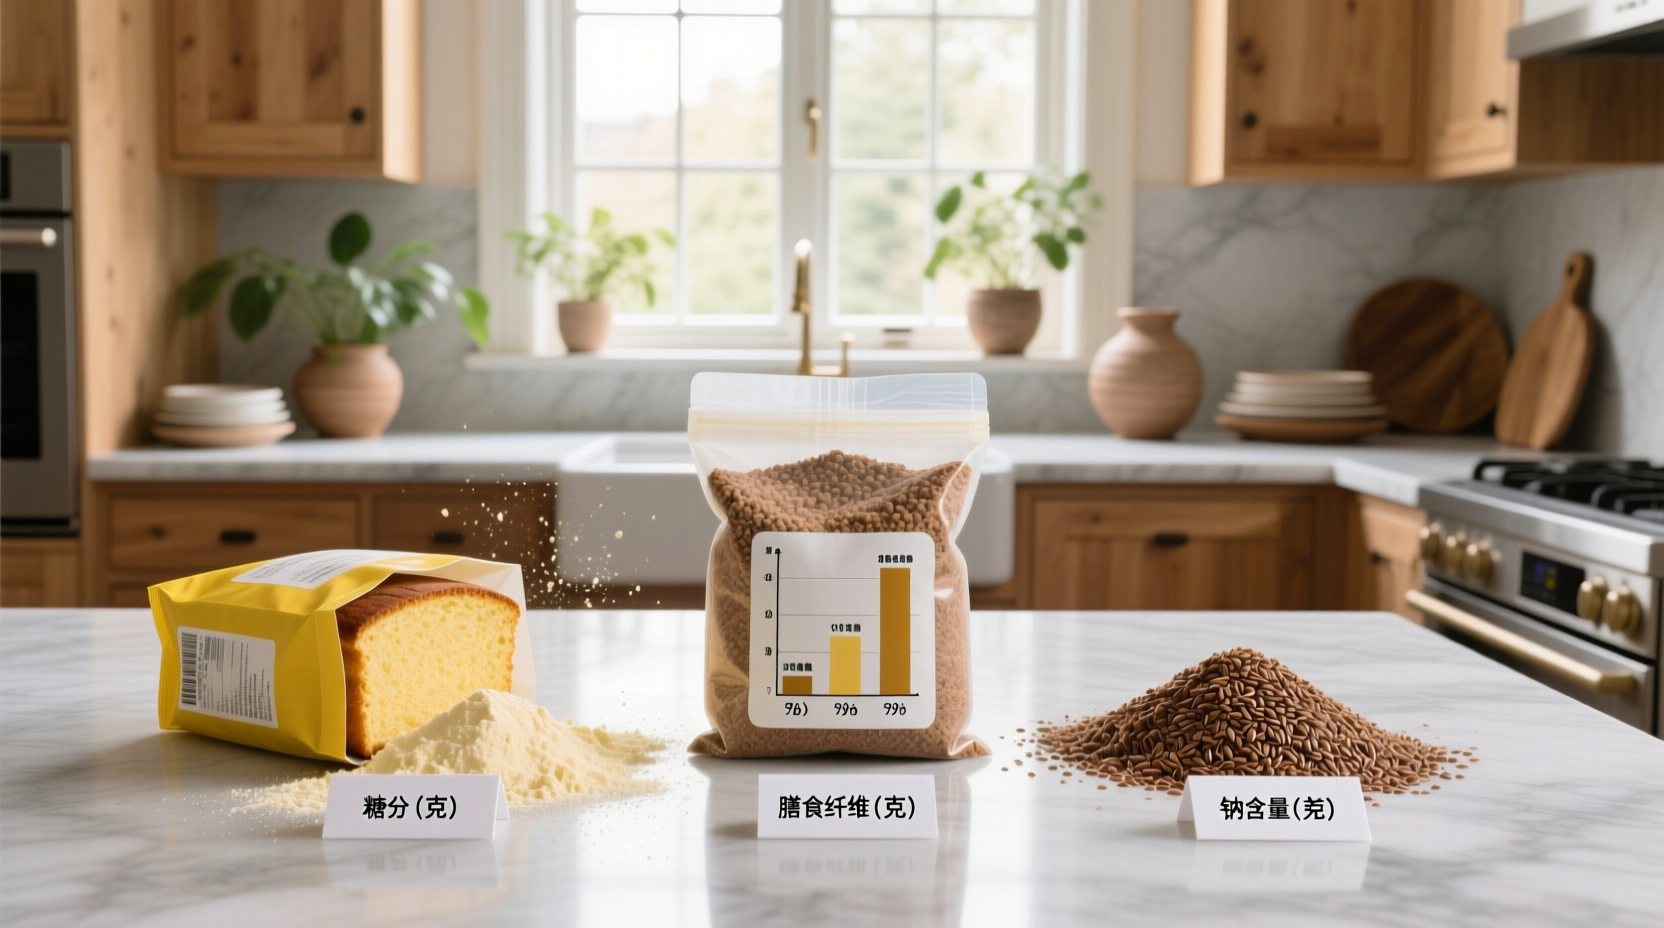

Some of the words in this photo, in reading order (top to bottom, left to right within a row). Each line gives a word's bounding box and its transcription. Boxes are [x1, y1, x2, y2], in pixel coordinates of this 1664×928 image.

[778, 794, 916, 820] 膳食纤维(克)
